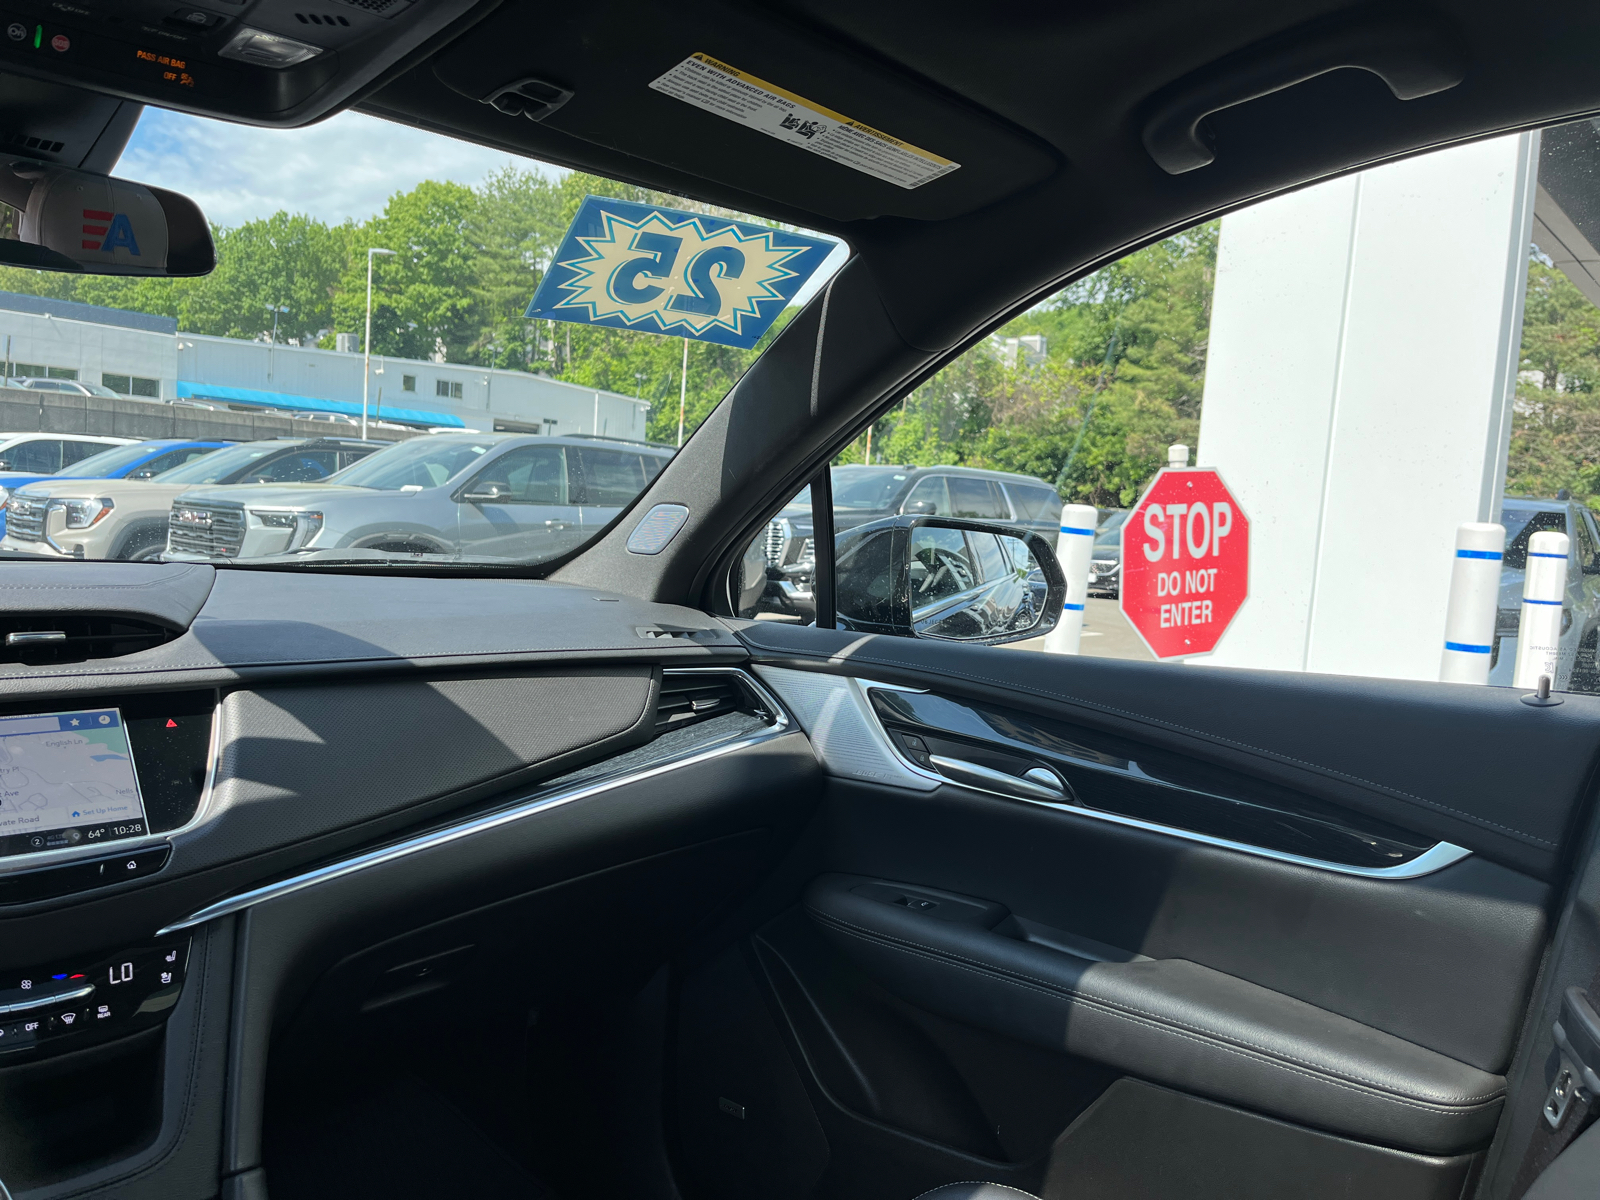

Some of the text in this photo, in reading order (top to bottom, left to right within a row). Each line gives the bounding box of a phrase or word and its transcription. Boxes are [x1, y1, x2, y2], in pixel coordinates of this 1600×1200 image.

[136, 50, 186, 69] PASS AIR BAG
[705, 58, 740, 77] WARNING
[163, 71, 178, 81] OFF
[686, 60, 707, 71] EVEN
[707, 69, 726, 79] WITH
[726, 78, 764, 95] ADVANCED
[777, 99, 796, 109] BAGS
[854, 124, 904, 147] AVERTISSEMENT
[1143, 501, 1233, 563] STOP
[1157, 568, 1217, 597] DO NOT
[1159, 600, 1213, 628] ENTER
[46, 739, 72, 747] English
[4, 789, 19, 798] Ave
[83, 805, 128, 816] Set Up Home
[18, 815, 40, 825] Road
[114, 824, 142, 835] 10:28
[109, 962, 134, 985] LO
[97, 1010, 111, 1019] REAR
[25, 1022, 39, 1031] OFF
